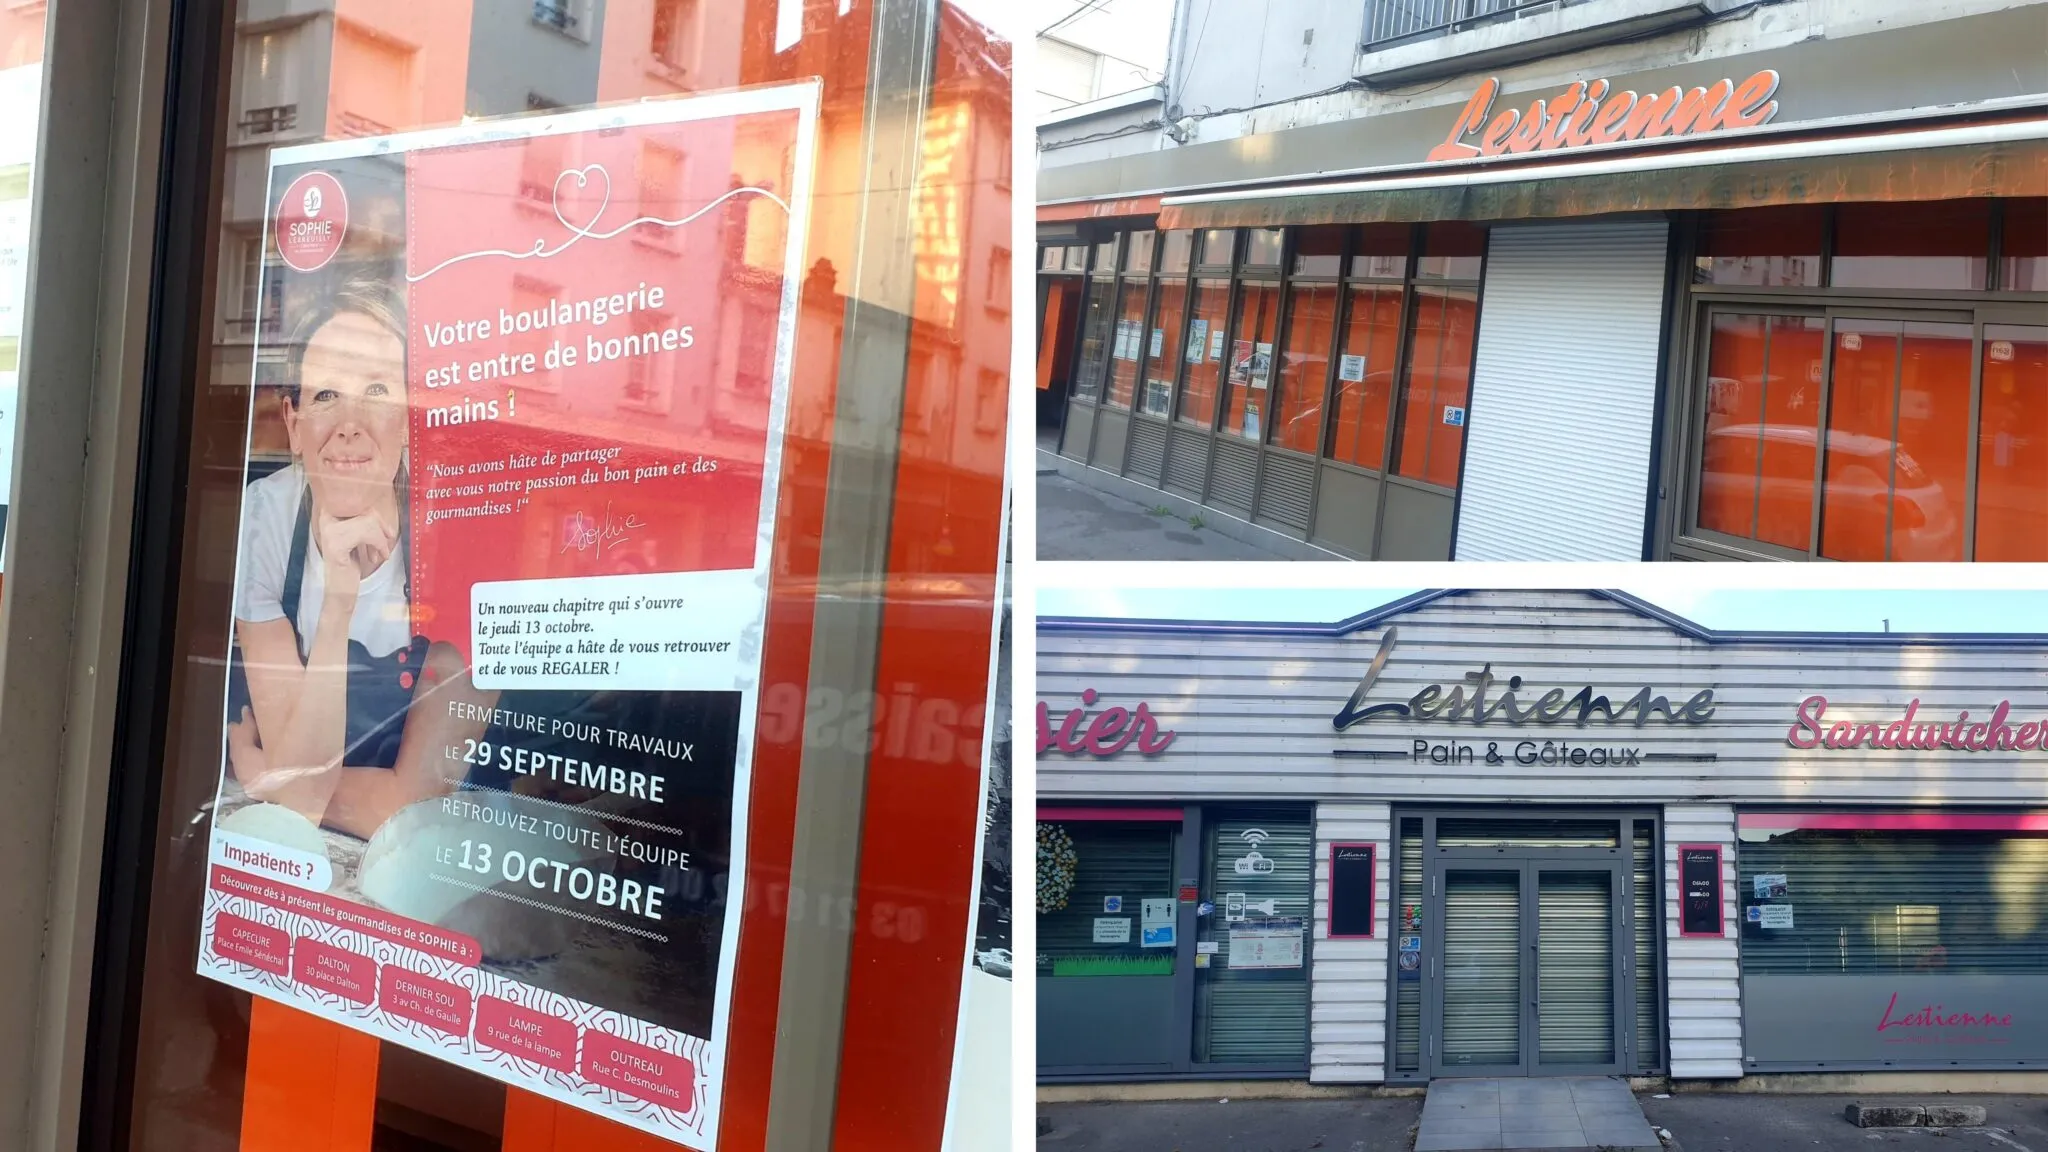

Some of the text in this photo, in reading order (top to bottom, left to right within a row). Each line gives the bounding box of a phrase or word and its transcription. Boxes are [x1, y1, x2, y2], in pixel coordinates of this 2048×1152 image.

[1426, 70, 1780, 162] Lestienne
[289, 221, 333, 236] SOPHIE
[423, 282, 664, 348] Votre boulangerie
[425, 324, 694, 389] est entre de bonnes
[425, 389, 515, 428] mains !
[468, 460, 505, 475] avons
[508, 454, 537, 470] hâte
[541, 451, 557, 466] de
[560, 445, 622, 468] partager
[425, 455, 718, 500] avec vous notre passion du bon pain et des
[425, 500, 512, 525] gourmandises
[478, 602, 496, 615] Un
[498, 603, 549, 615] nouveau
[552, 598, 604, 616] chapitre
[608, 598, 630, 615] qui
[478, 619, 594, 638] le jeudi 13 octobre.
[478, 642, 511, 656] Toute
[565, 644, 573, 654] a
[577, 639, 605, 654] hâte
[609, 639, 624, 654] de
[629, 643, 660, 653] vous
[664, 641, 731, 653] retrouver
[478, 662, 620, 675] et de vous REGALER !
[1332, 627, 1716, 732] Lestienne
[448, 701, 694, 762] FERMETURE POUR TRAVAUX
[1412, 739, 1641, 768] Pain & Gâteaux
[445, 738, 666, 803] LE 29 SEPTEMBRE
[442, 797, 538, 835] RETROUVEZ
[543, 820, 600, 850] TOUTE
[224, 841, 314, 880] Impatients ?
[435, 839, 666, 920] LE 13 OCTOBRE
[219, 873, 262, 895] Découvrez
[263, 885, 279, 900] dès
[280, 889, 287, 902] à
[287, 893, 321, 912] présent
[322, 902, 335, 916] les
[336, 908, 402, 937] gourmandises
[403, 927, 417, 941] de
[418, 931, 457, 955] SOPHIE
[459, 942, 467, 956] à
[217, 936, 235, 950] Place
[254, 948, 284, 967] Sénéchal
[232, 927, 272, 949] CAPECURE
[305, 966, 360, 991] 30 place Dalton
[318, 955, 350, 973] DALTON
[395, 979, 455, 1008] DERNIER SOU
[392, 995, 461, 1025] 3 av Ch. de Gaulle
[1877, 991, 2013, 1032] Lestienne
[509, 1017, 543, 1037] LAMPE
[487, 1026, 562, 1060] 9 rue de la lampe
[610, 1050, 663, 1076] OUTREAU
[592, 1060, 680, 1099] Rue C. Desmoulins
